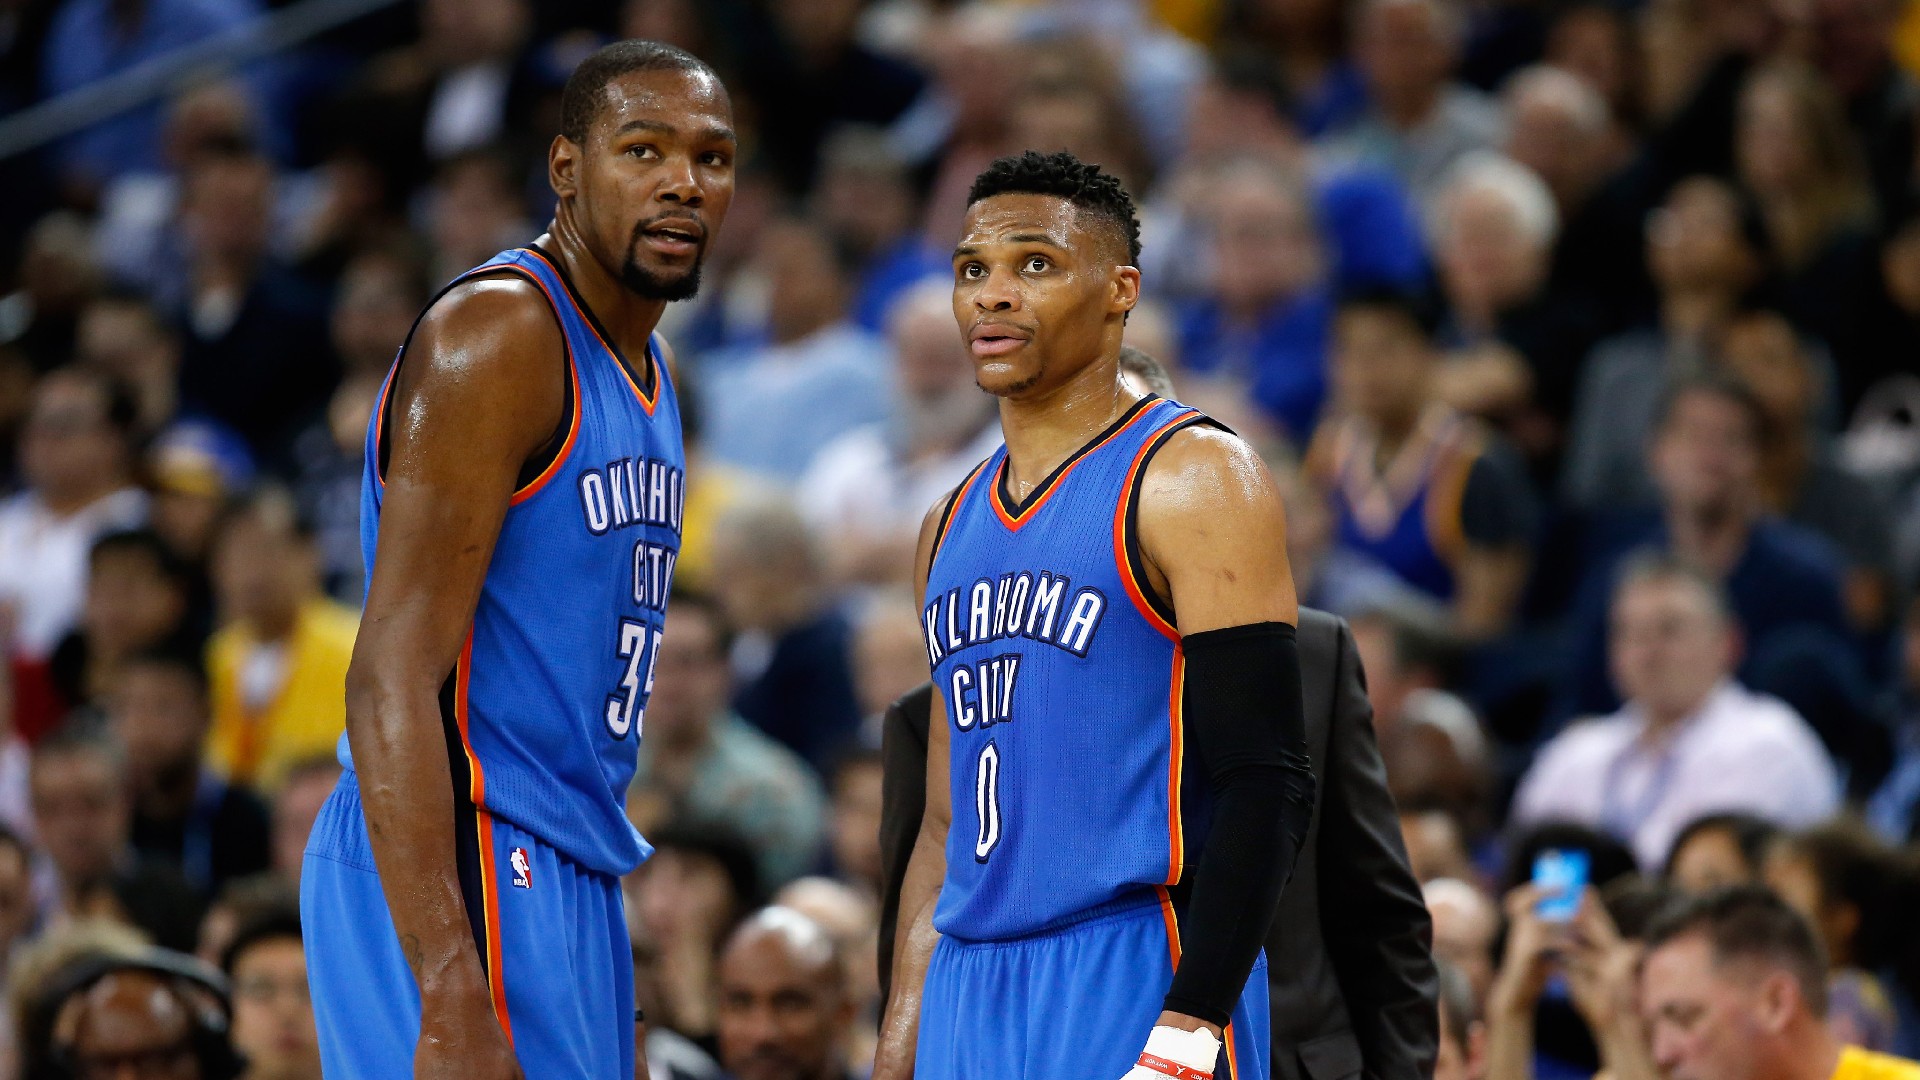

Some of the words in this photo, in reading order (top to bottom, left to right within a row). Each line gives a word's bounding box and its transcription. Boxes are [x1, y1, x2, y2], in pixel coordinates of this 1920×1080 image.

[577, 455, 685, 537] OKLAHO
[633, 538, 679, 614] CITY
[921, 570, 1107, 672] KLAHOMA
[951, 653, 1023, 732] CITY
[974, 737, 1002, 864] 0
